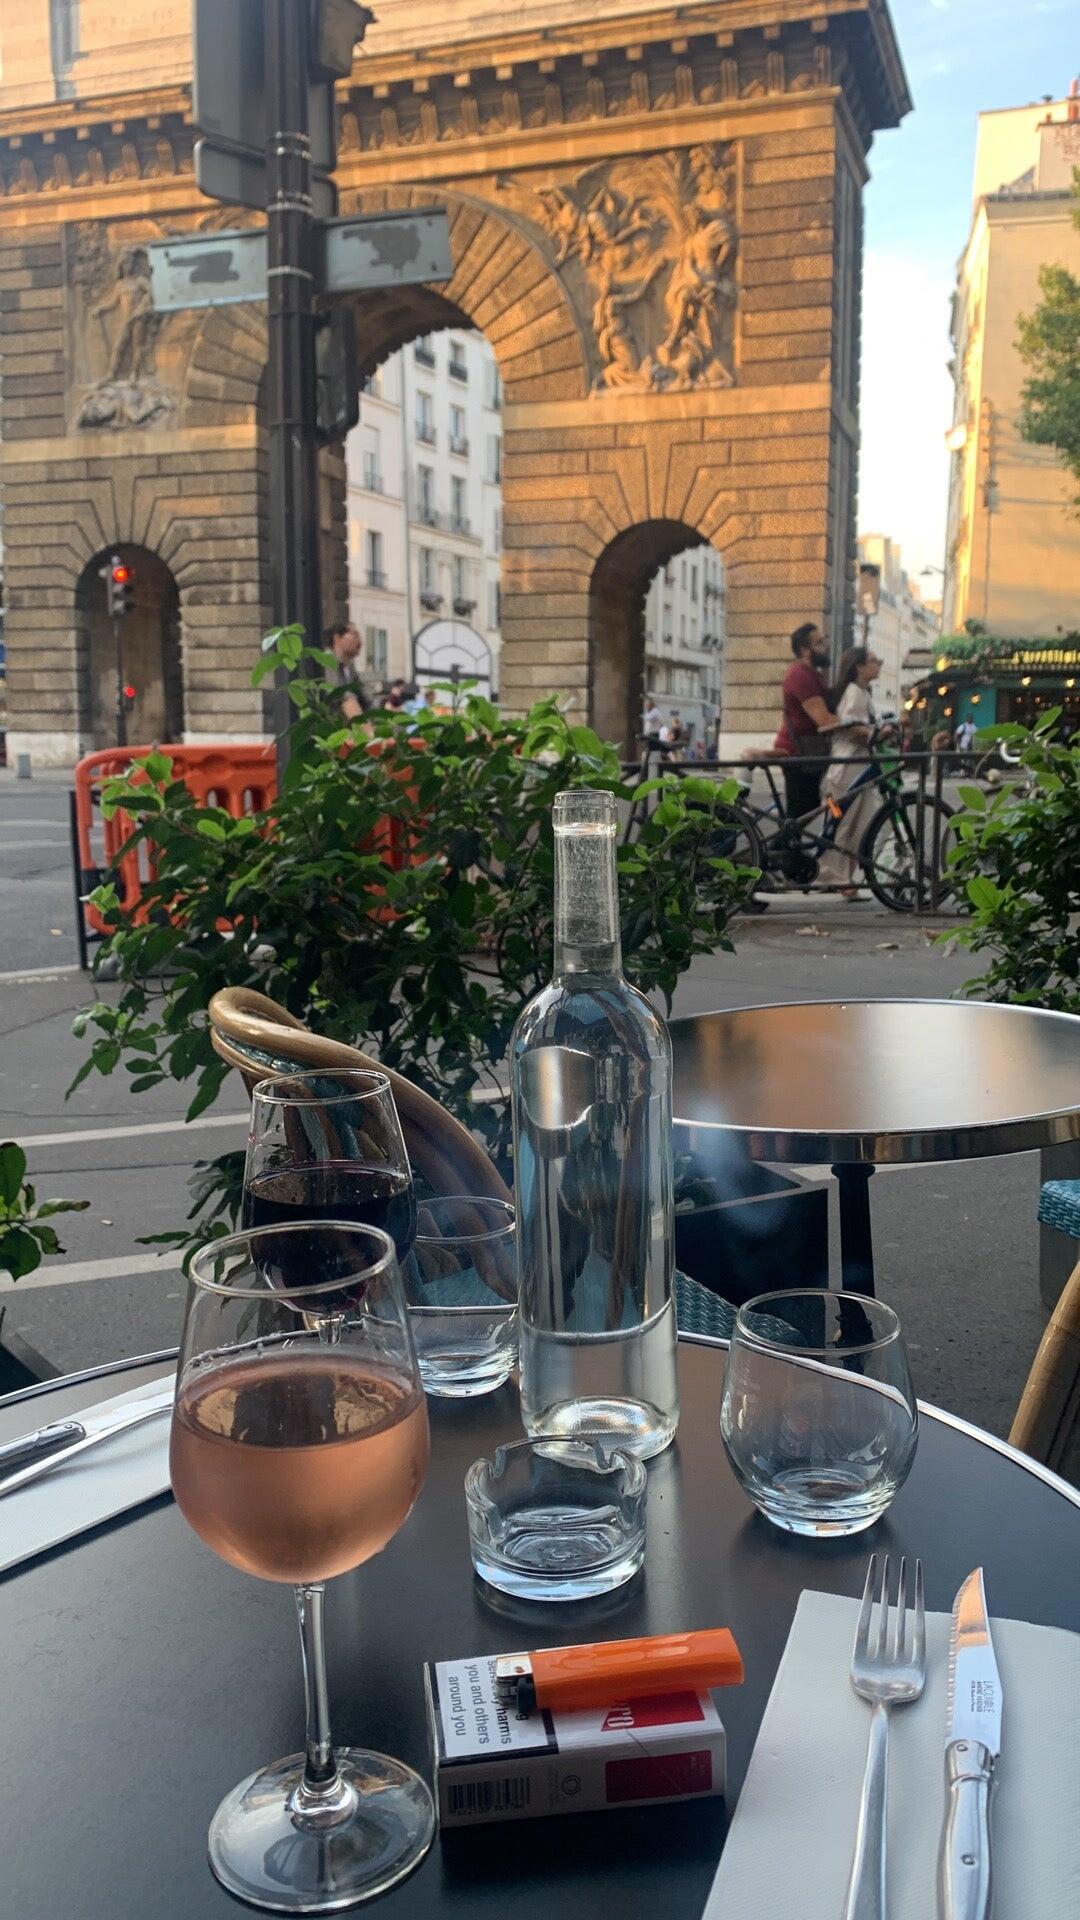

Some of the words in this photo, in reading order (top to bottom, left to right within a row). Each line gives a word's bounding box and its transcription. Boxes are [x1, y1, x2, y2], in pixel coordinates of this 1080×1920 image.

[464, 1664, 480, 1683] you
[448, 1676, 467, 1713] around
[470, 1685, 487, 1705] and
[450, 1715, 466, 1736] you
[474, 1707, 490, 1745] others
[496, 1707, 512, 1745] harms
